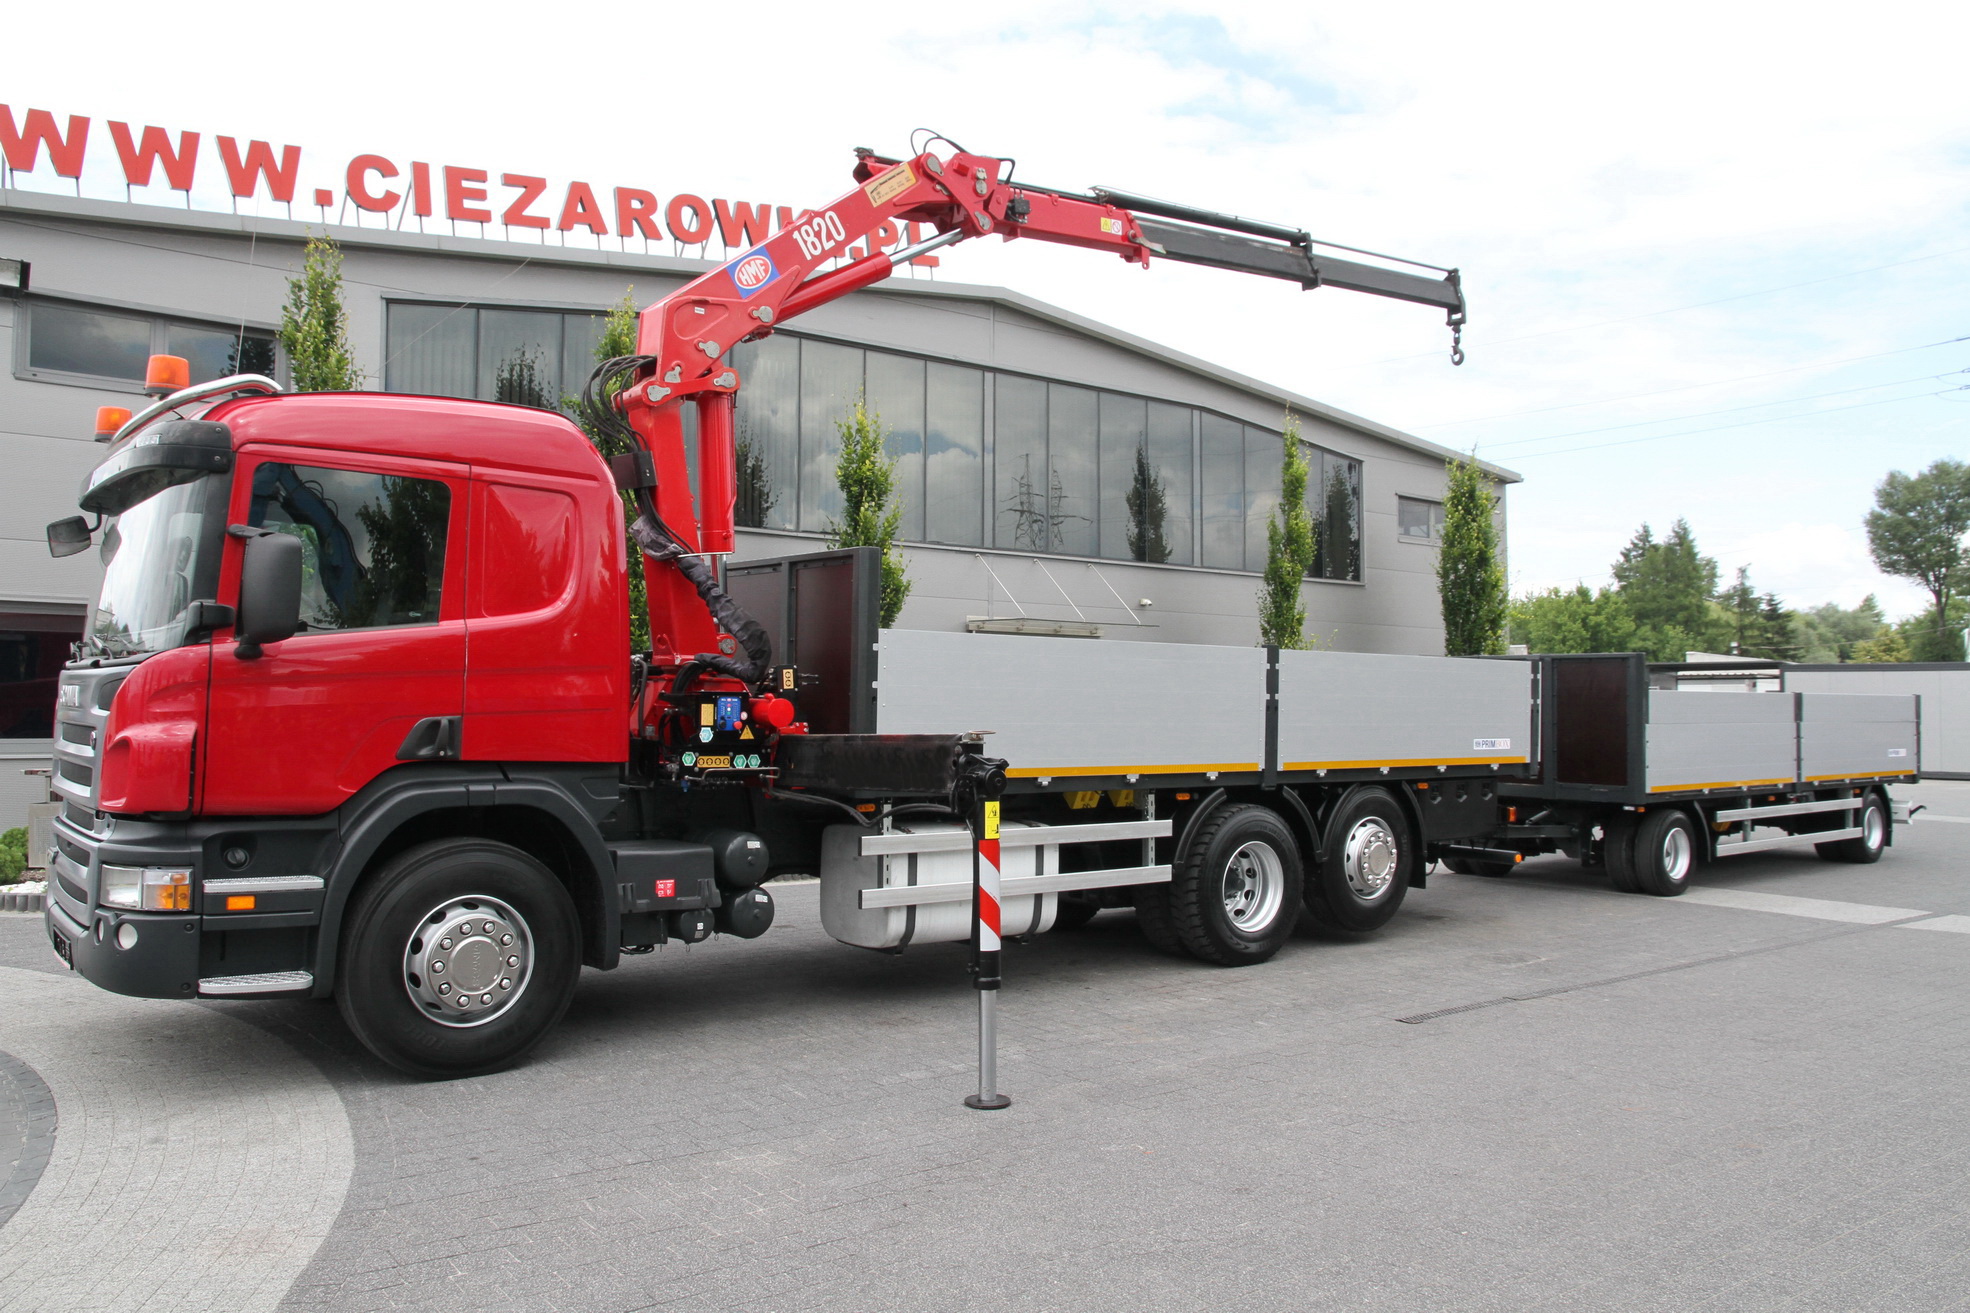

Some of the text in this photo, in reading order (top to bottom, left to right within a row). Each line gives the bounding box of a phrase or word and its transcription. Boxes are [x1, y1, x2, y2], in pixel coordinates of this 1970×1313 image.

[0, 104, 940, 268] WWW.CIEZAROW.PL
[792, 211, 845, 260] 1820
[739, 259, 767, 286] HMF
